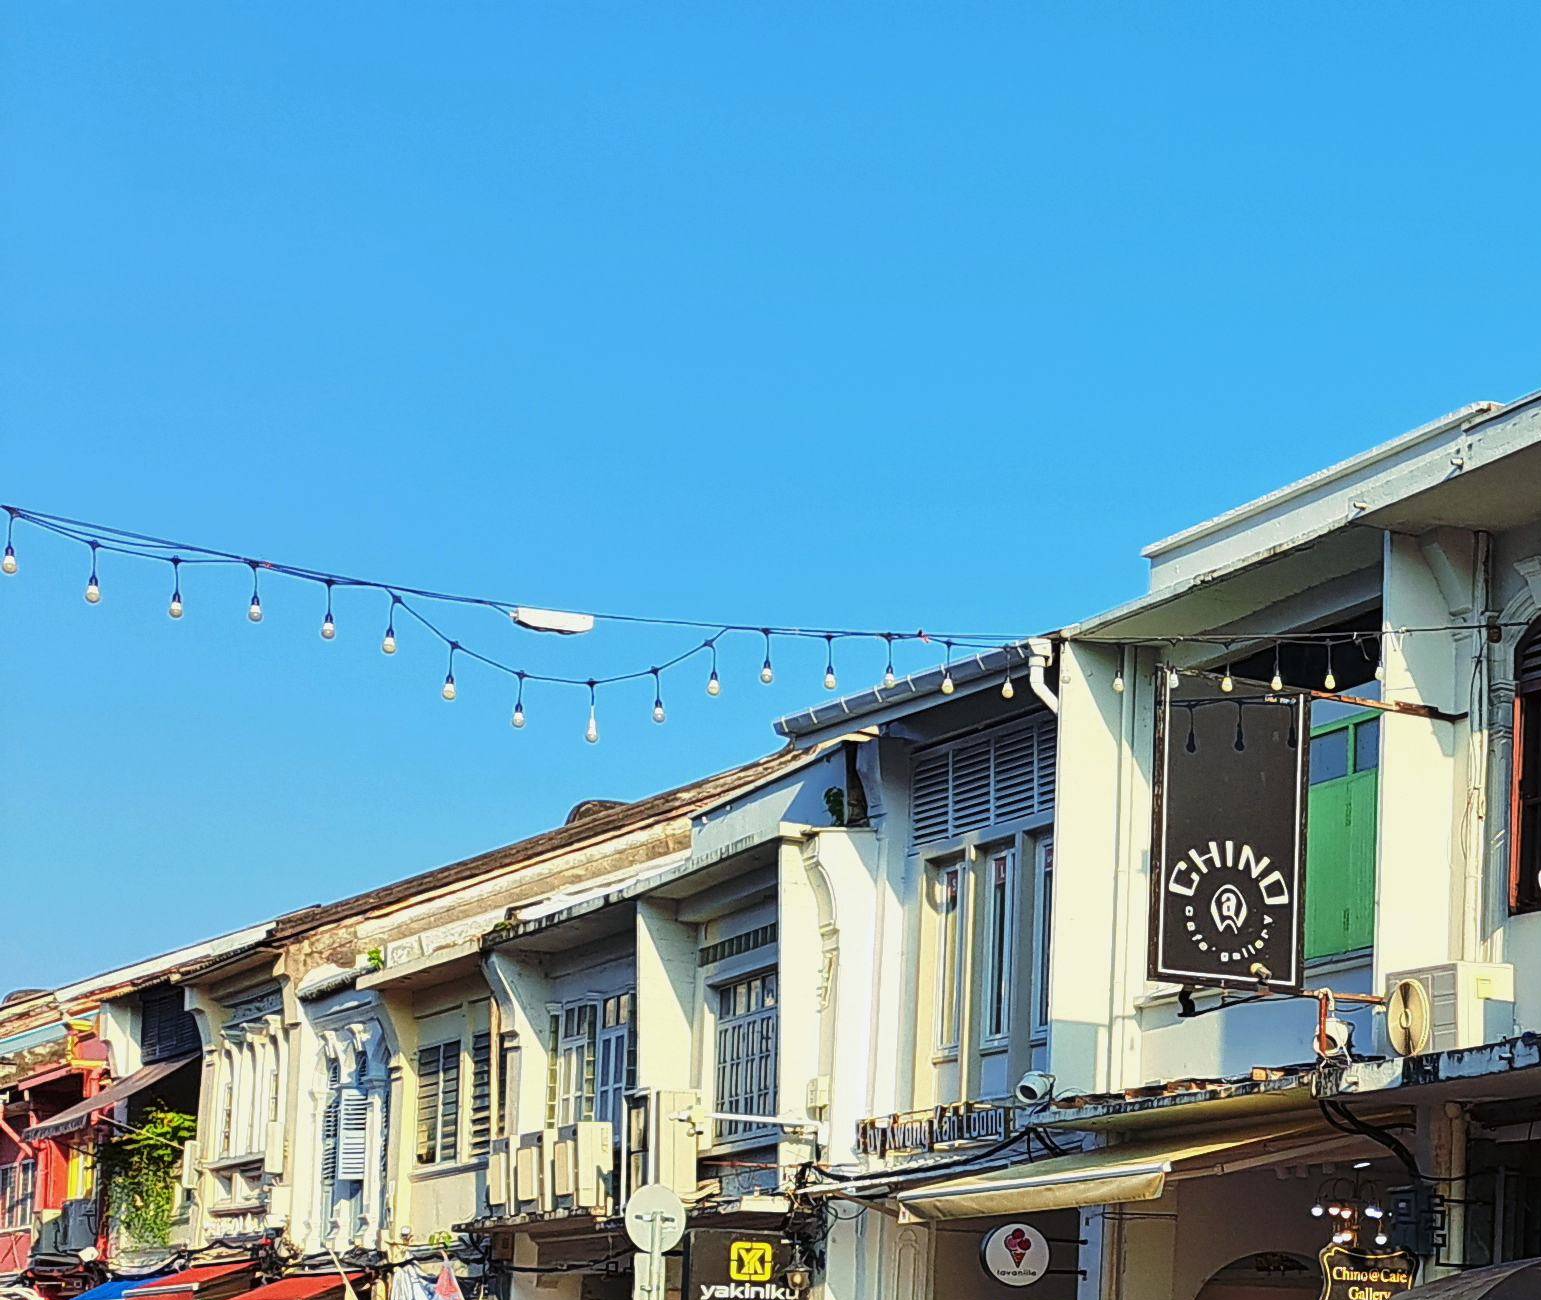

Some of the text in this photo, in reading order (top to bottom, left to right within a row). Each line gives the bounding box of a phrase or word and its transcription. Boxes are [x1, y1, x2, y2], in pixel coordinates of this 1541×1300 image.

[1168, 840, 1289, 905] CHINO
[886, 1115, 929, 1153] Kwong
[932, 1104, 958, 1142] Kah
[963, 1102, 1005, 1141] Loong
[700, 1282, 799, 1300] yakiniku
